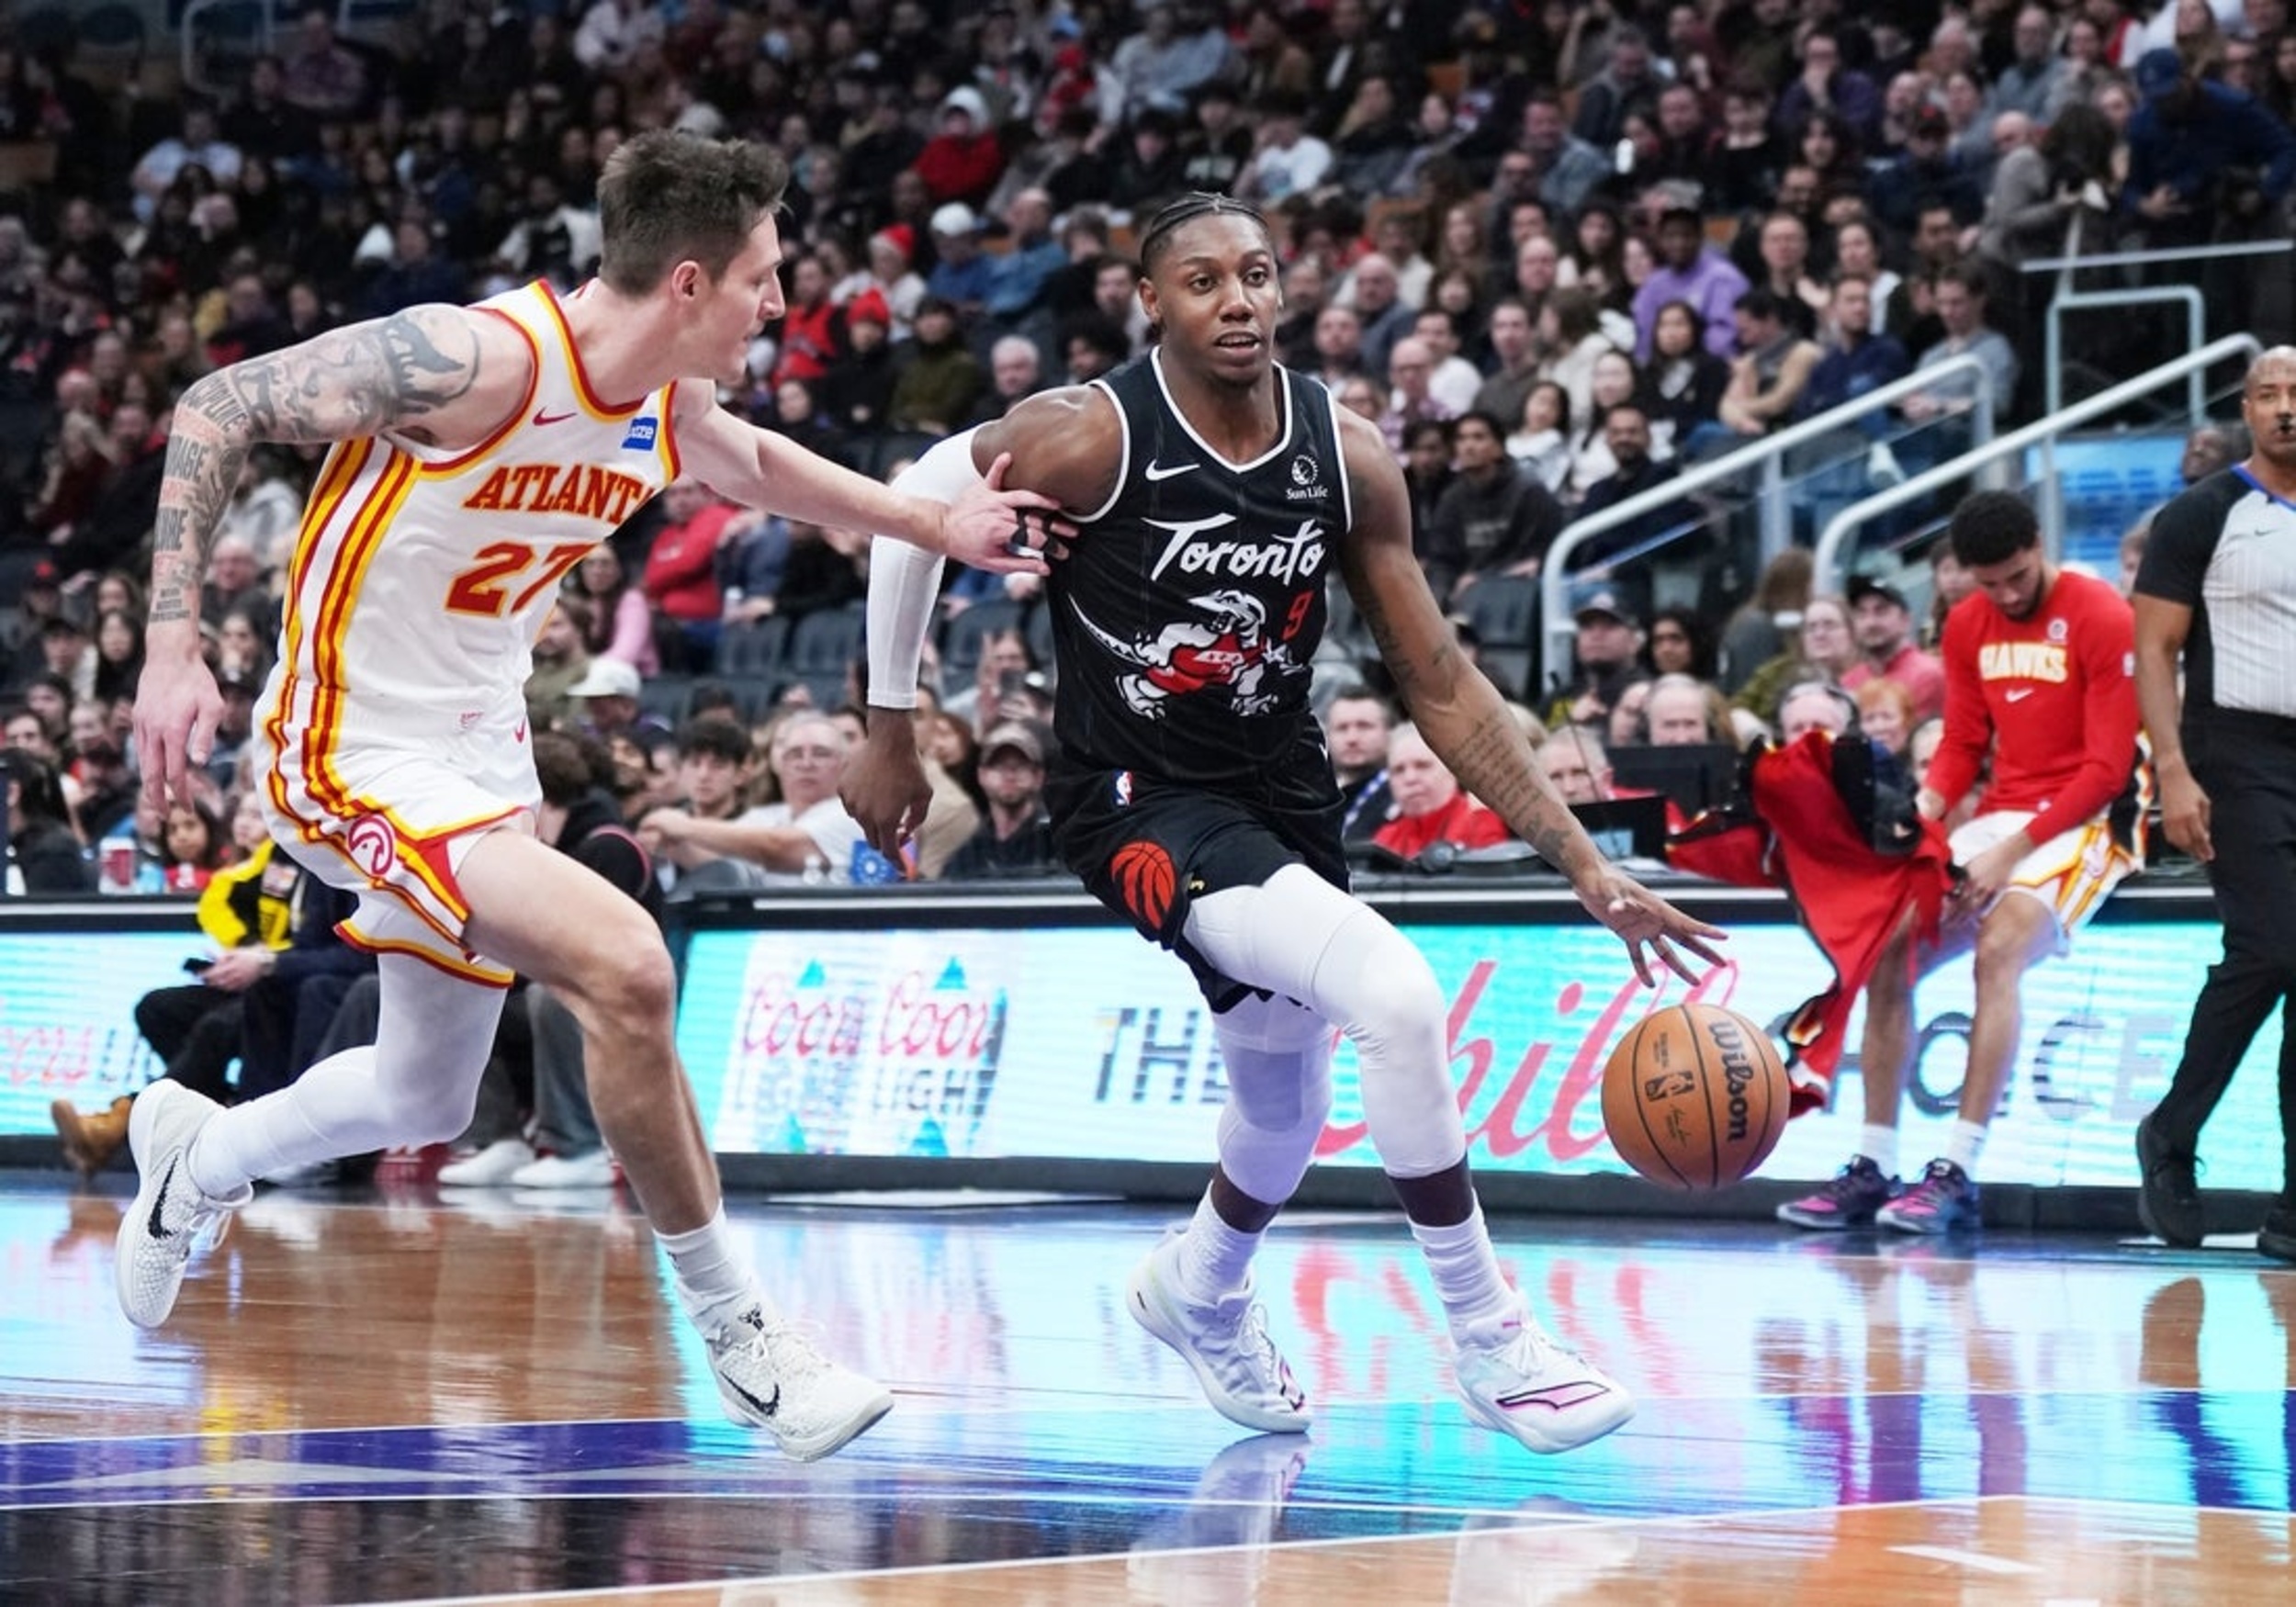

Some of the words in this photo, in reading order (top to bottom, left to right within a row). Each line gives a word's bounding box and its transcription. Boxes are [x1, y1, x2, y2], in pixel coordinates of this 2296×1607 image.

[463, 464, 656, 525] ATLANT
[1286, 487, 1306, 500] Sun
[1307, 485, 1328, 500] Life
[445, 541, 597, 618] 27
[1141, 512, 1326, 586] Toronto
[1281, 590, 1315, 640] 9
[1978, 642, 2068, 683] HAWKS
[1709, 1021, 1754, 1142] Wilson
